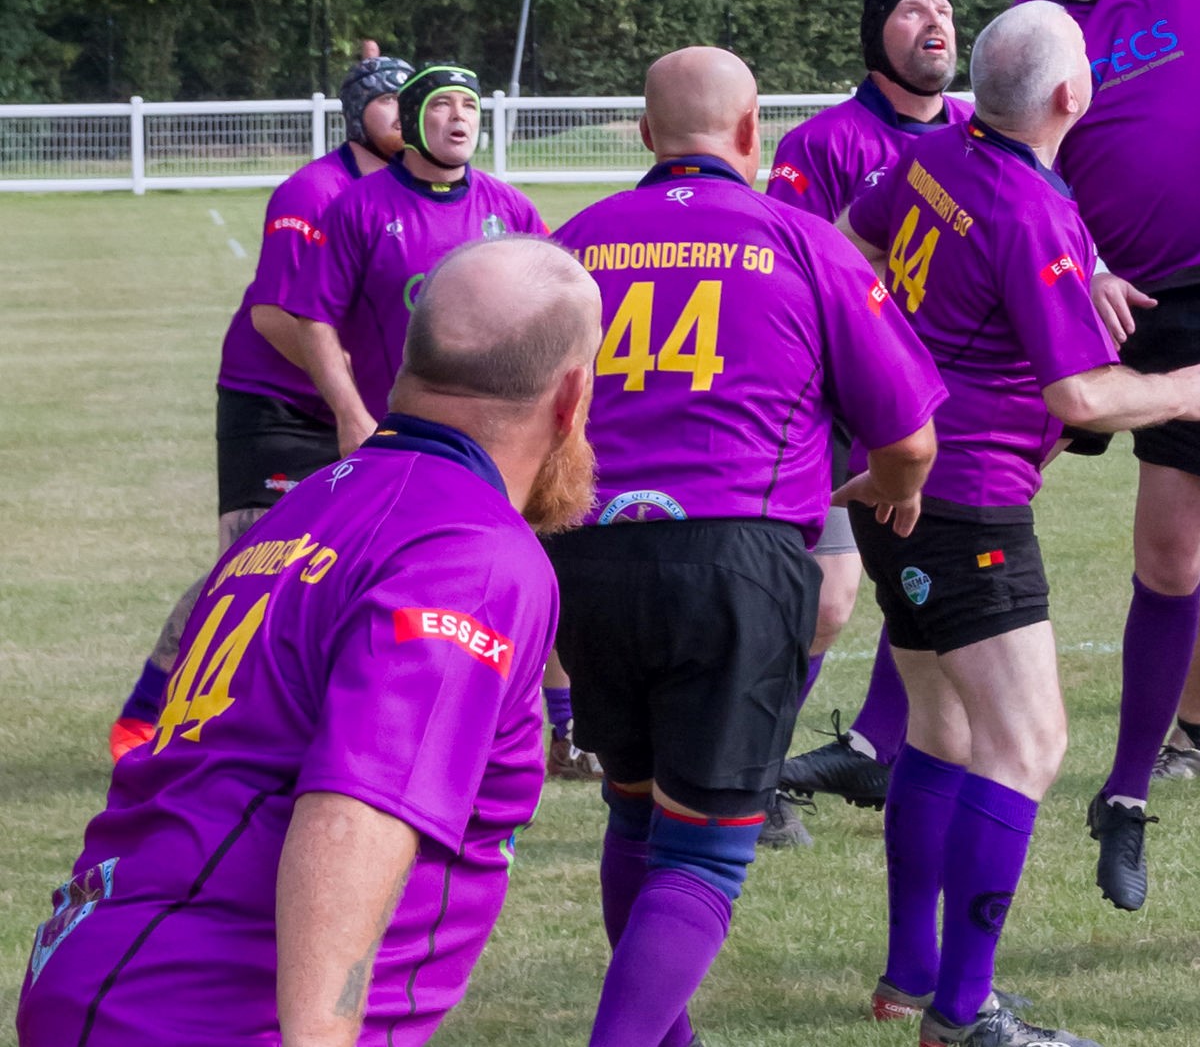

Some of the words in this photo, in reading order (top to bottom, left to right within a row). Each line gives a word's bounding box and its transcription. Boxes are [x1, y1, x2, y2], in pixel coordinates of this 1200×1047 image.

[742, 245, 775, 275] 50
[889, 204, 941, 314] 44
[953, 209, 974, 237] 50
[595, 279, 725, 392] 44
[153, 592, 271, 756] 44
[421, 612, 508, 663] ESSEX
